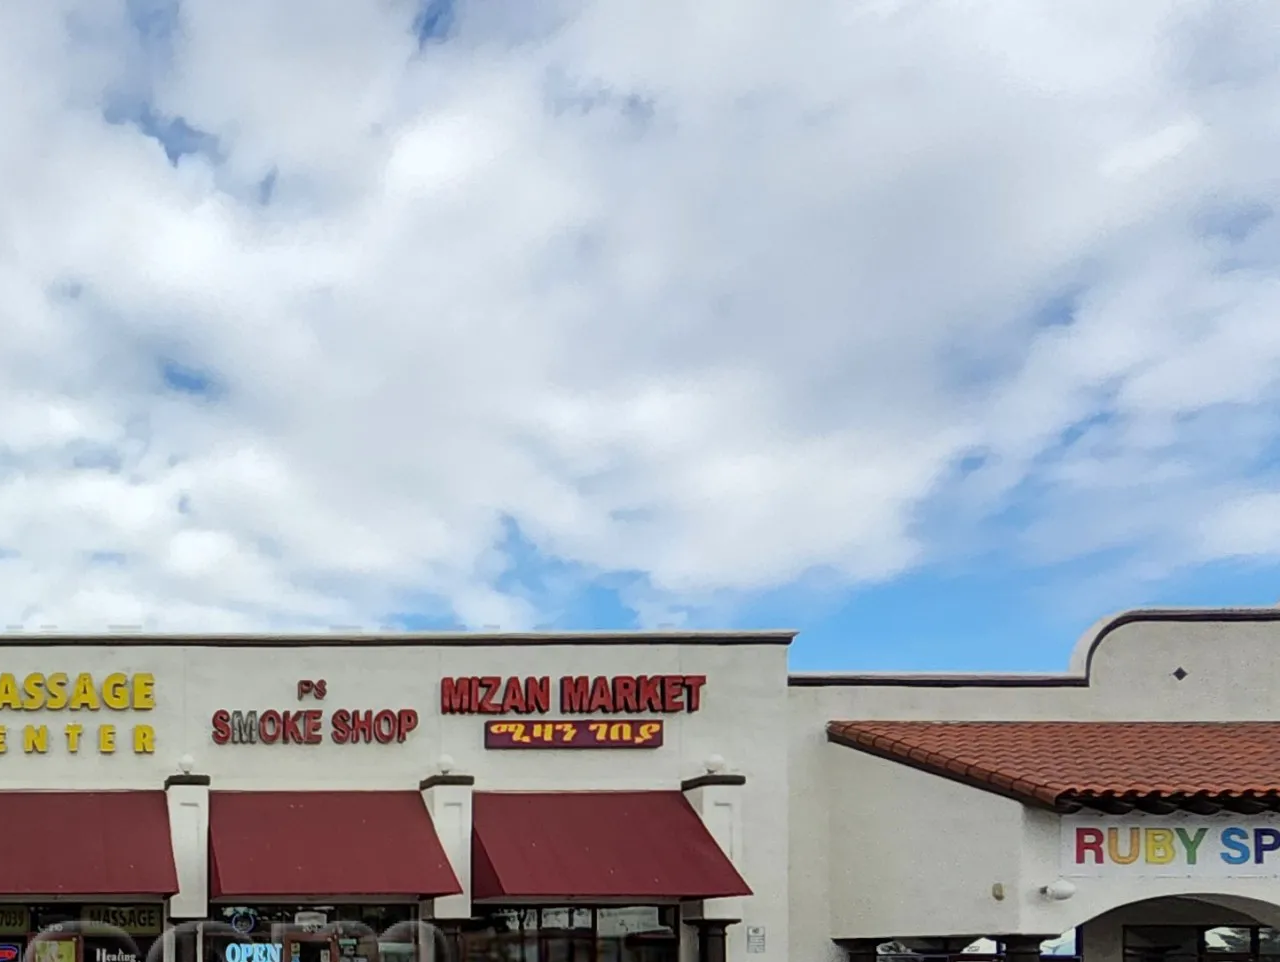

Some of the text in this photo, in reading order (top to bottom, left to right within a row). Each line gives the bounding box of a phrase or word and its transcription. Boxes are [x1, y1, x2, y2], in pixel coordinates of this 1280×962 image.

[297, 679, 327, 701] PS
[440, 675, 707, 714] MIZAN MARKET
[211, 708, 418, 745] SMOKE SHOP
[1075, 826, 1280, 865] RUBY SP
[90, 909, 155, 927] MASSAGE
